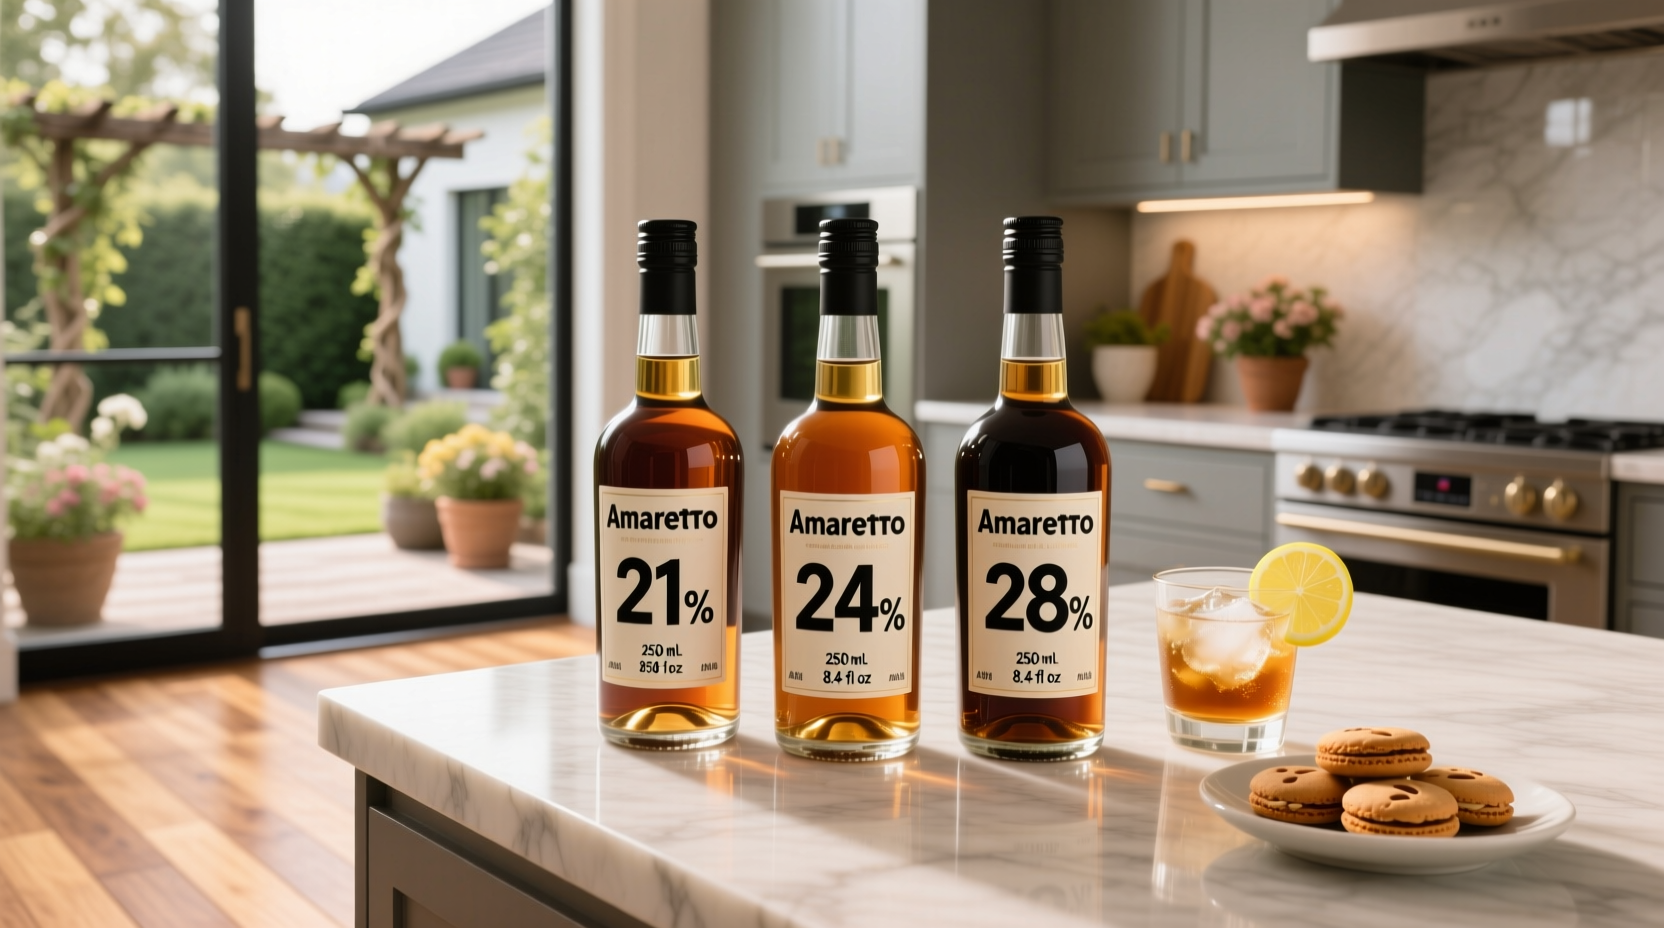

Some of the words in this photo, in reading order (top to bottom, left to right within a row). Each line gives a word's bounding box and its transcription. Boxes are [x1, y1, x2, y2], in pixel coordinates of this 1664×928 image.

[617, 557, 714, 626] 21%
[795, 562, 906, 633] 24%
[985, 562, 1094, 633] 28%
[641, 644, 664, 657] 250
[666, 643, 683, 657] mL
[825, 652, 849, 666] 250
[850, 652, 869, 666] mL
[1016, 651, 1040, 665] 250
[669, 664, 684, 674] oz
[1012, 669, 1033, 684] 8.4
[1034, 669, 1044, 684] fl
[1046, 673, 1062, 684] oz
[822, 670, 843, 684] 8.4
[845, 670, 855, 685] fl
[857, 673, 872, 684] oz
